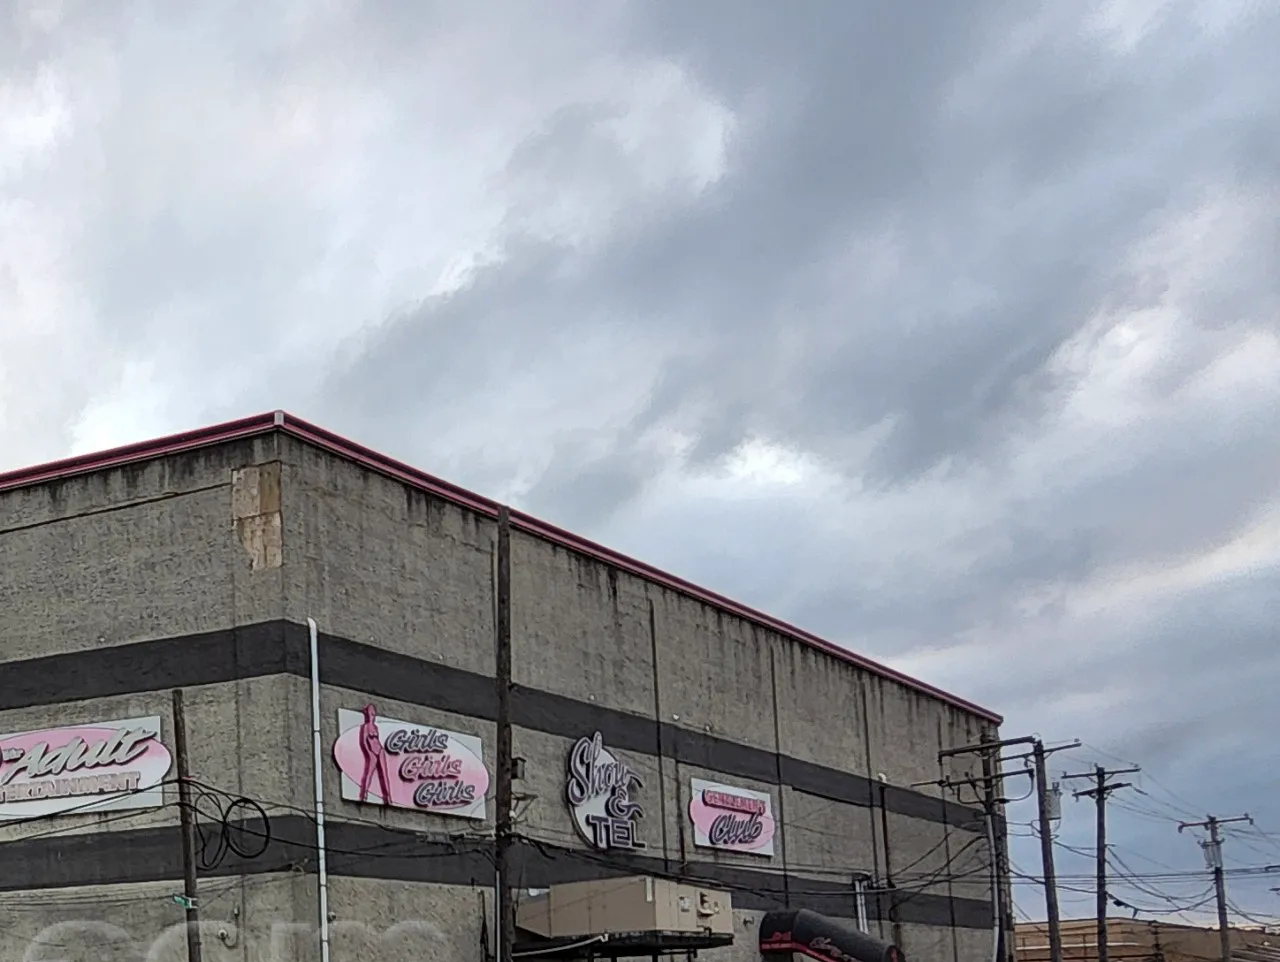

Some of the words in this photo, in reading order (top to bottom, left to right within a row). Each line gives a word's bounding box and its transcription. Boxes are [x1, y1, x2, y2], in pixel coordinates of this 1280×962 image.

[1, 726, 158, 784] Adult
[568, 731, 643, 807] Show
[586, 814, 648, 850] TEL
